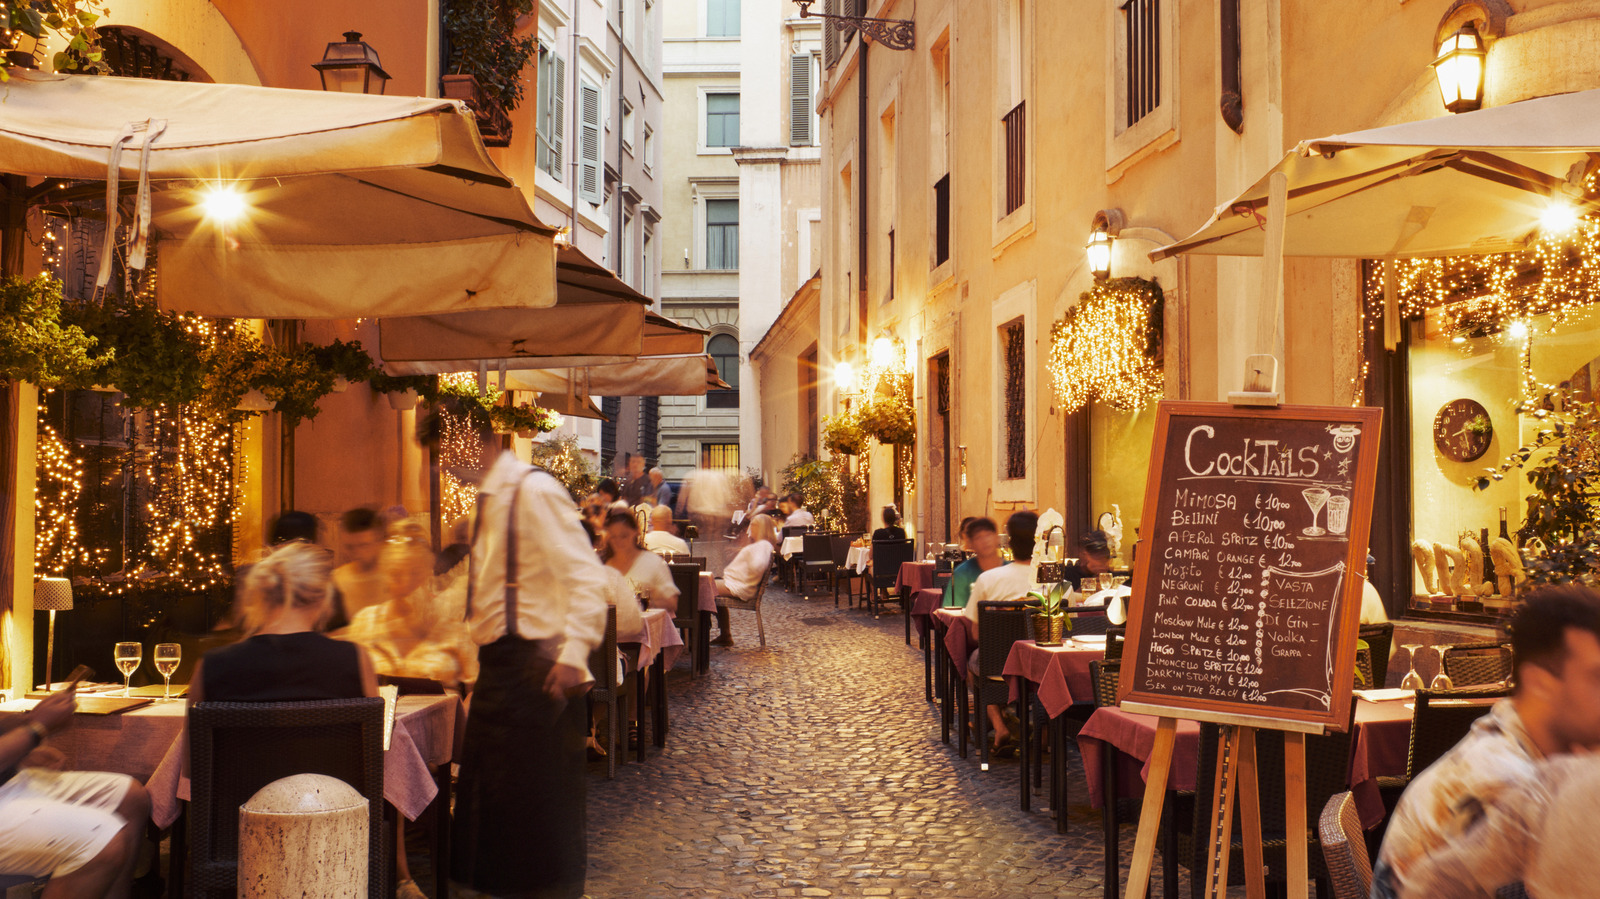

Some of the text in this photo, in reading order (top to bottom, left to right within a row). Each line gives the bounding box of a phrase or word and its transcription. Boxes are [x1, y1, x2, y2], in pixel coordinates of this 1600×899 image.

[1216, 551, 1256, 565] ORANGE
[1258, 553, 1267, 569] €
[1275, 578, 1315, 593] VASTA
[1271, 644, 1302, 657] GRAPPA
[1172, 684, 1184, 692] ON
[1185, 684, 1204, 695] THE
[1208, 684, 1239, 698] BEACH
